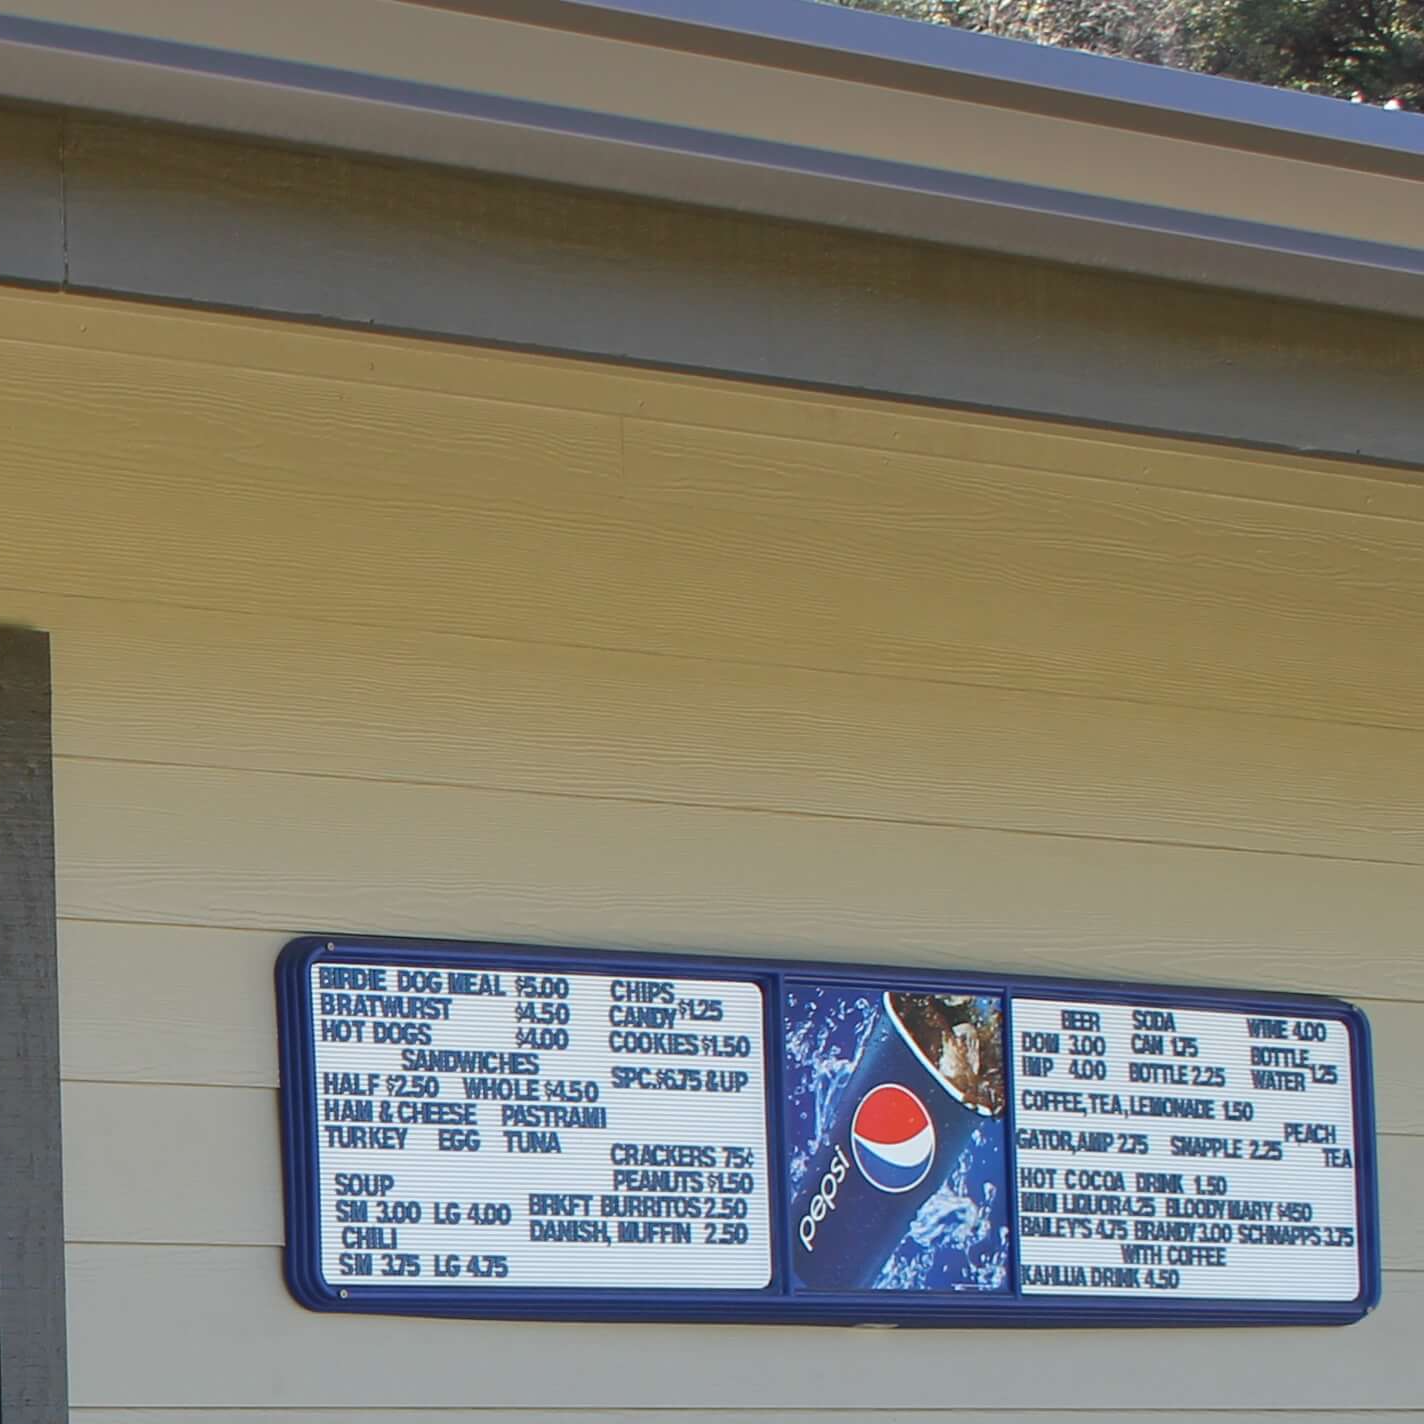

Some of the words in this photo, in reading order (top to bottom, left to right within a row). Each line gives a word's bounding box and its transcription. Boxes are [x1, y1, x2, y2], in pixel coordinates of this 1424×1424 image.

[319, 966, 387, 991] BIRDIE
[398, 970, 444, 993] DOG
[448, 972, 506, 997] MEAL
[515, 975, 570, 999] $5.00
[610, 979, 675, 1004] CHIPS
[320, 993, 453, 1020] BRATWURST
[515, 1001, 570, 1025] $4.50
[609, 1004, 677, 1029] CANDY
[321, 1019, 366, 1042] HOT
[373, 1021, 433, 1045] DOGS
[515, 1026, 570, 1050] $4.00
[1061, 1009, 1101, 1032] BEER
[1132, 1009, 1176, 1032] SODA
[1246, 1018, 1288, 1039] WINE
[609, 1030, 699, 1056] COOKIES
[1021, 1032, 1060, 1053] DOM
[1131, 1033, 1163, 1055] CAN
[401, 1049, 540, 1075] SANDWICHES
[1250, 1045, 1311, 1069] BOTTLE
[1022, 1055, 1053, 1077] IMP
[1129, 1061, 1189, 1085] BOTTLE
[1250, 1068, 1306, 1092] WATER
[323, 1072, 381, 1096] HALF
[386, 1075, 440, 1098] $2.50
[463, 1077, 540, 1101] WHOLE
[544, 1079, 599, 1103] $4.50
[324, 1100, 373, 1123] HAM
[397, 1102, 478, 1125] CHEESE
[502, 1104, 607, 1129] PASTRAMI
[1130, 1095, 1215, 1120] LEMONADE
[324, 1125, 408, 1150] TURKEY
[438, 1128, 481, 1151] EGG
[503, 1131, 562, 1153] TUNA
[1283, 1122, 1336, 1144] PEACH
[610, 1143, 716, 1168] CRACKERS
[1170, 1135, 1243, 1158] SNAPPLE
[1321, 1147, 1353, 1168] TEA
[335, 1173, 395, 1197] SOUP
[613, 1169, 702, 1193] PEANUTS
[1020, 1167, 1057, 1189] HOT
[1064, 1169, 1125, 1192] COCOA
[1135, 1172, 1185, 1194] DRINK
[600, 1194, 702, 1219] BURRITOS
[799, 1144, 850, 1252] pepsi
[1165, 1197, 1225, 1220] BLOODY
[1228, 1199, 1272, 1221] MARY
[335, 1200, 368, 1223] SM
[376, 1201, 422, 1224] 3.00
[433, 1202, 461, 1225] LG
[467, 1203, 512, 1226] 4.00
[341, 1226, 398, 1250] CHILI
[530, 1219, 612, 1247] DANISH,
[618, 1221, 692, 1245] MUFFIN
[704, 1222, 749, 1245] 2.50
[1134, 1219, 1195, 1242] BRANDY
[1237, 1224, 1320, 1246] SCHNAPPS
[339, 1253, 373, 1276] SM
[433, 1254, 461, 1278] LG
[467, 1255, 509, 1278] 4.75
[1120, 1244, 1162, 1265] WITH
[1168, 1245, 1227, 1267] COFFEE
[1021, 1264, 1087, 1287] KAHLUA
[1091, 1266, 1140, 1288] DRINK
